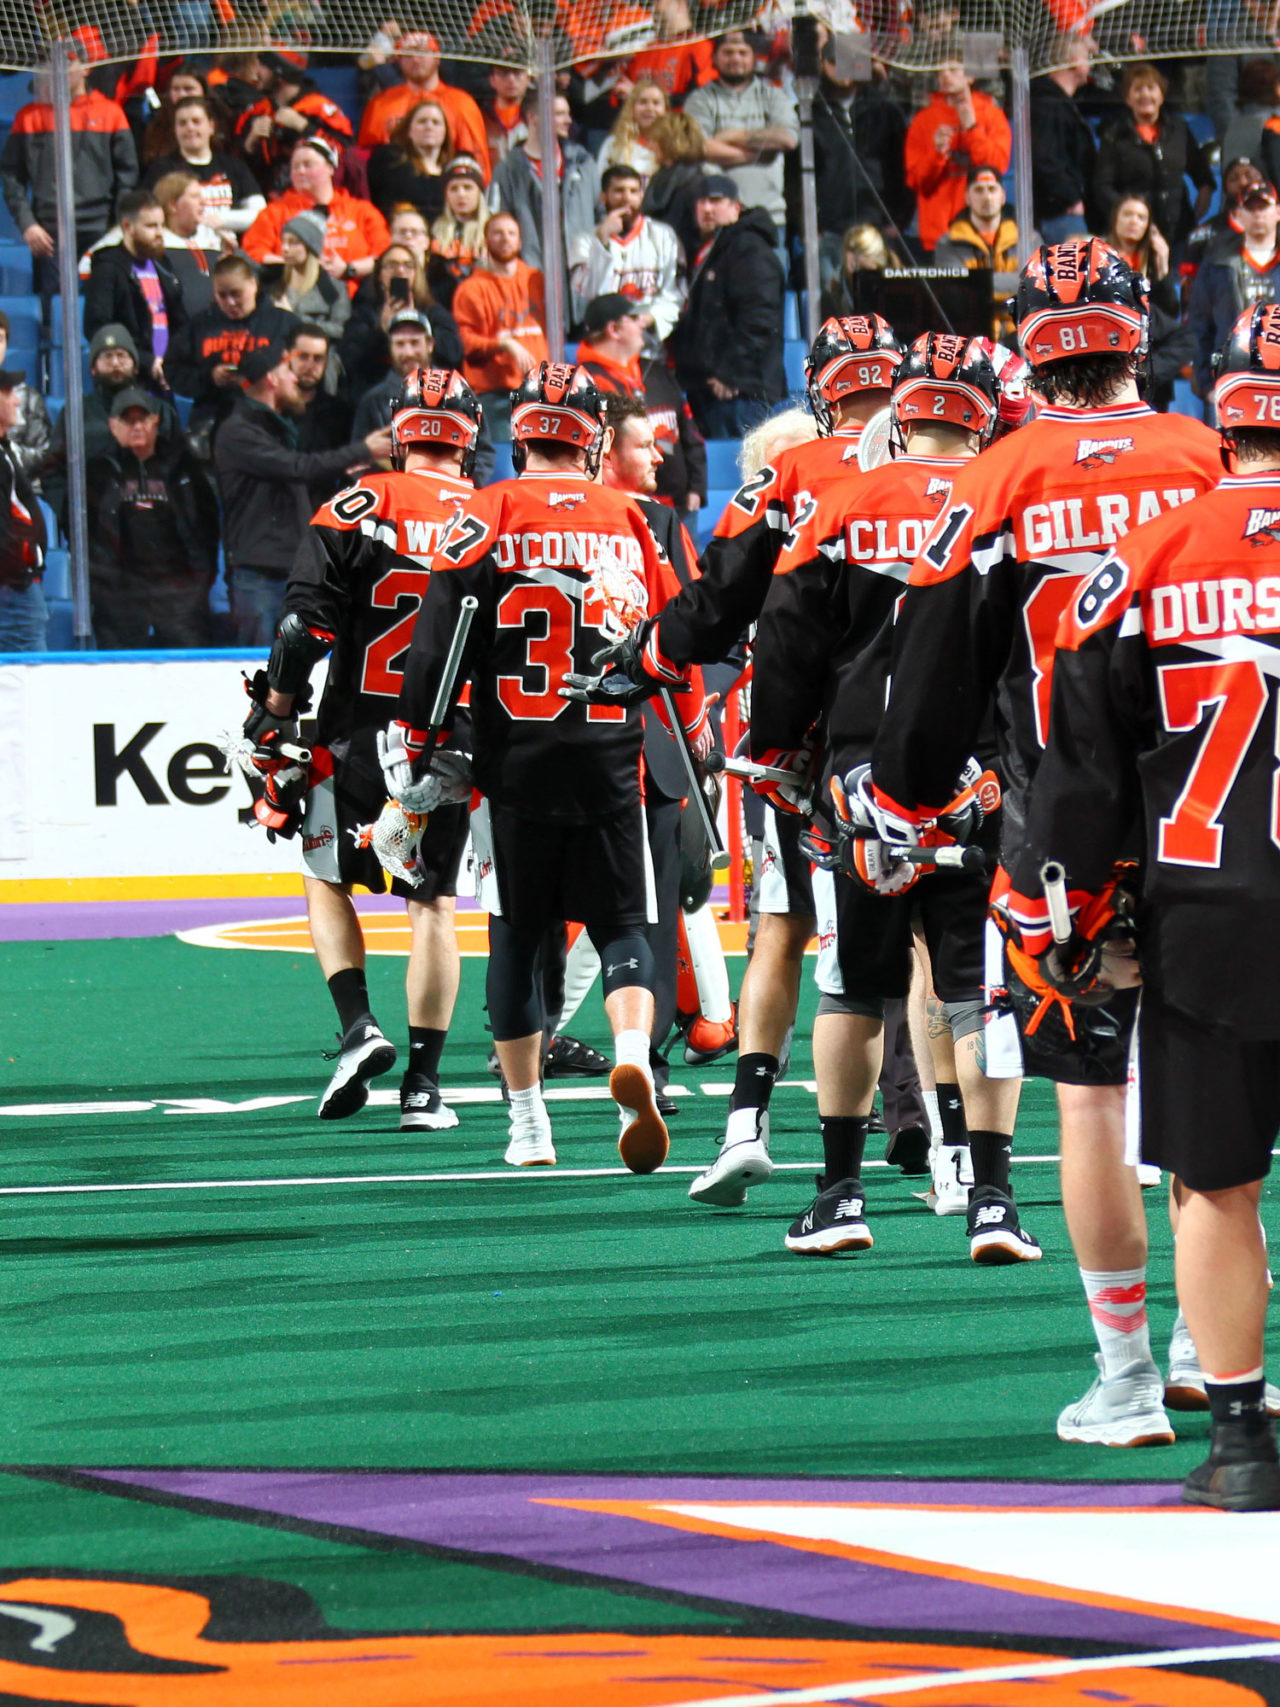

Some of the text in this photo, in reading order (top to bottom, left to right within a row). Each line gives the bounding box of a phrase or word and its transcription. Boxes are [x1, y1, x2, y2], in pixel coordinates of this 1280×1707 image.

[883, 267, 970, 278] DAKTRONICS
[1059, 324, 1089, 351] 81
[857, 364, 883, 387] 92
[932, 395, 946, 416] 2
[419, 419, 441, 436] 20
[538, 416, 562, 435] 37
[1077, 436, 1135, 460] BANDITS
[730, 464, 778, 517] 2
[849, 519, 932, 561] CLO
[922, 501, 974, 572] 1
[494, 531, 645, 573] O'CONNOR
